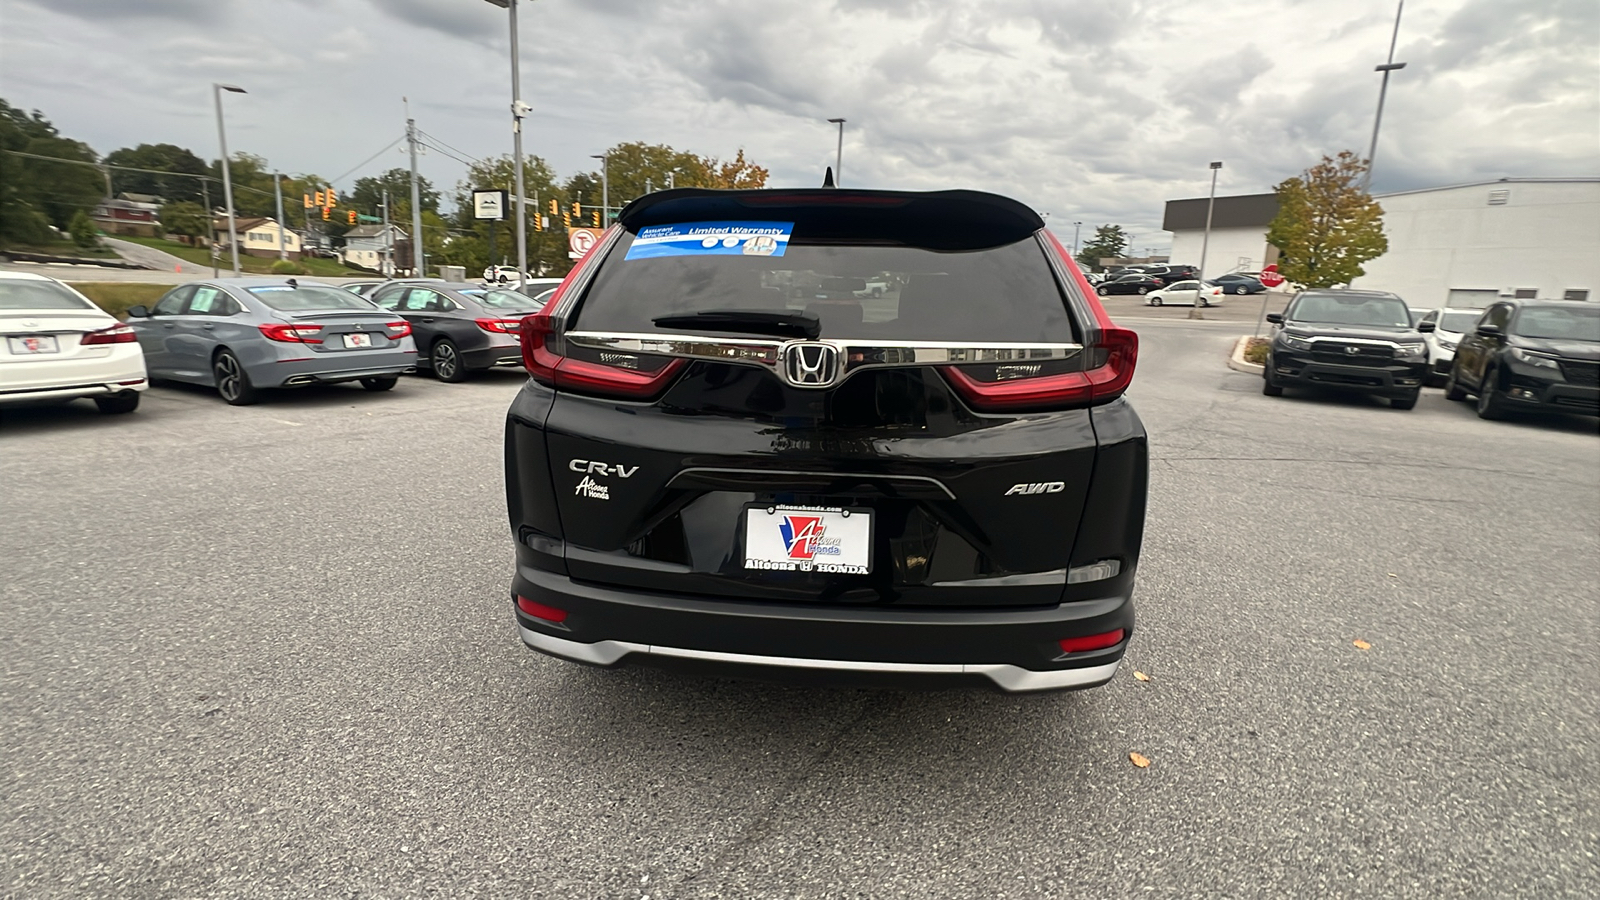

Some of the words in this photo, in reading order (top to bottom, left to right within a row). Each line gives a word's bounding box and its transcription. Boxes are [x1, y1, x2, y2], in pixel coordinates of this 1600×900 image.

[688, 227, 729, 235] Limited
[730, 227, 784, 235] Warranty
[569, 459, 640, 478] CR-V
[1004, 481, 1066, 496] AWD
[588, 490, 610, 500] Honda
[775, 504, 842, 512] altoonahonda.com
[809, 545, 840, 555] Honda
[744, 560, 796, 571] Altoona
[817, 563, 869, 575] HONDA
